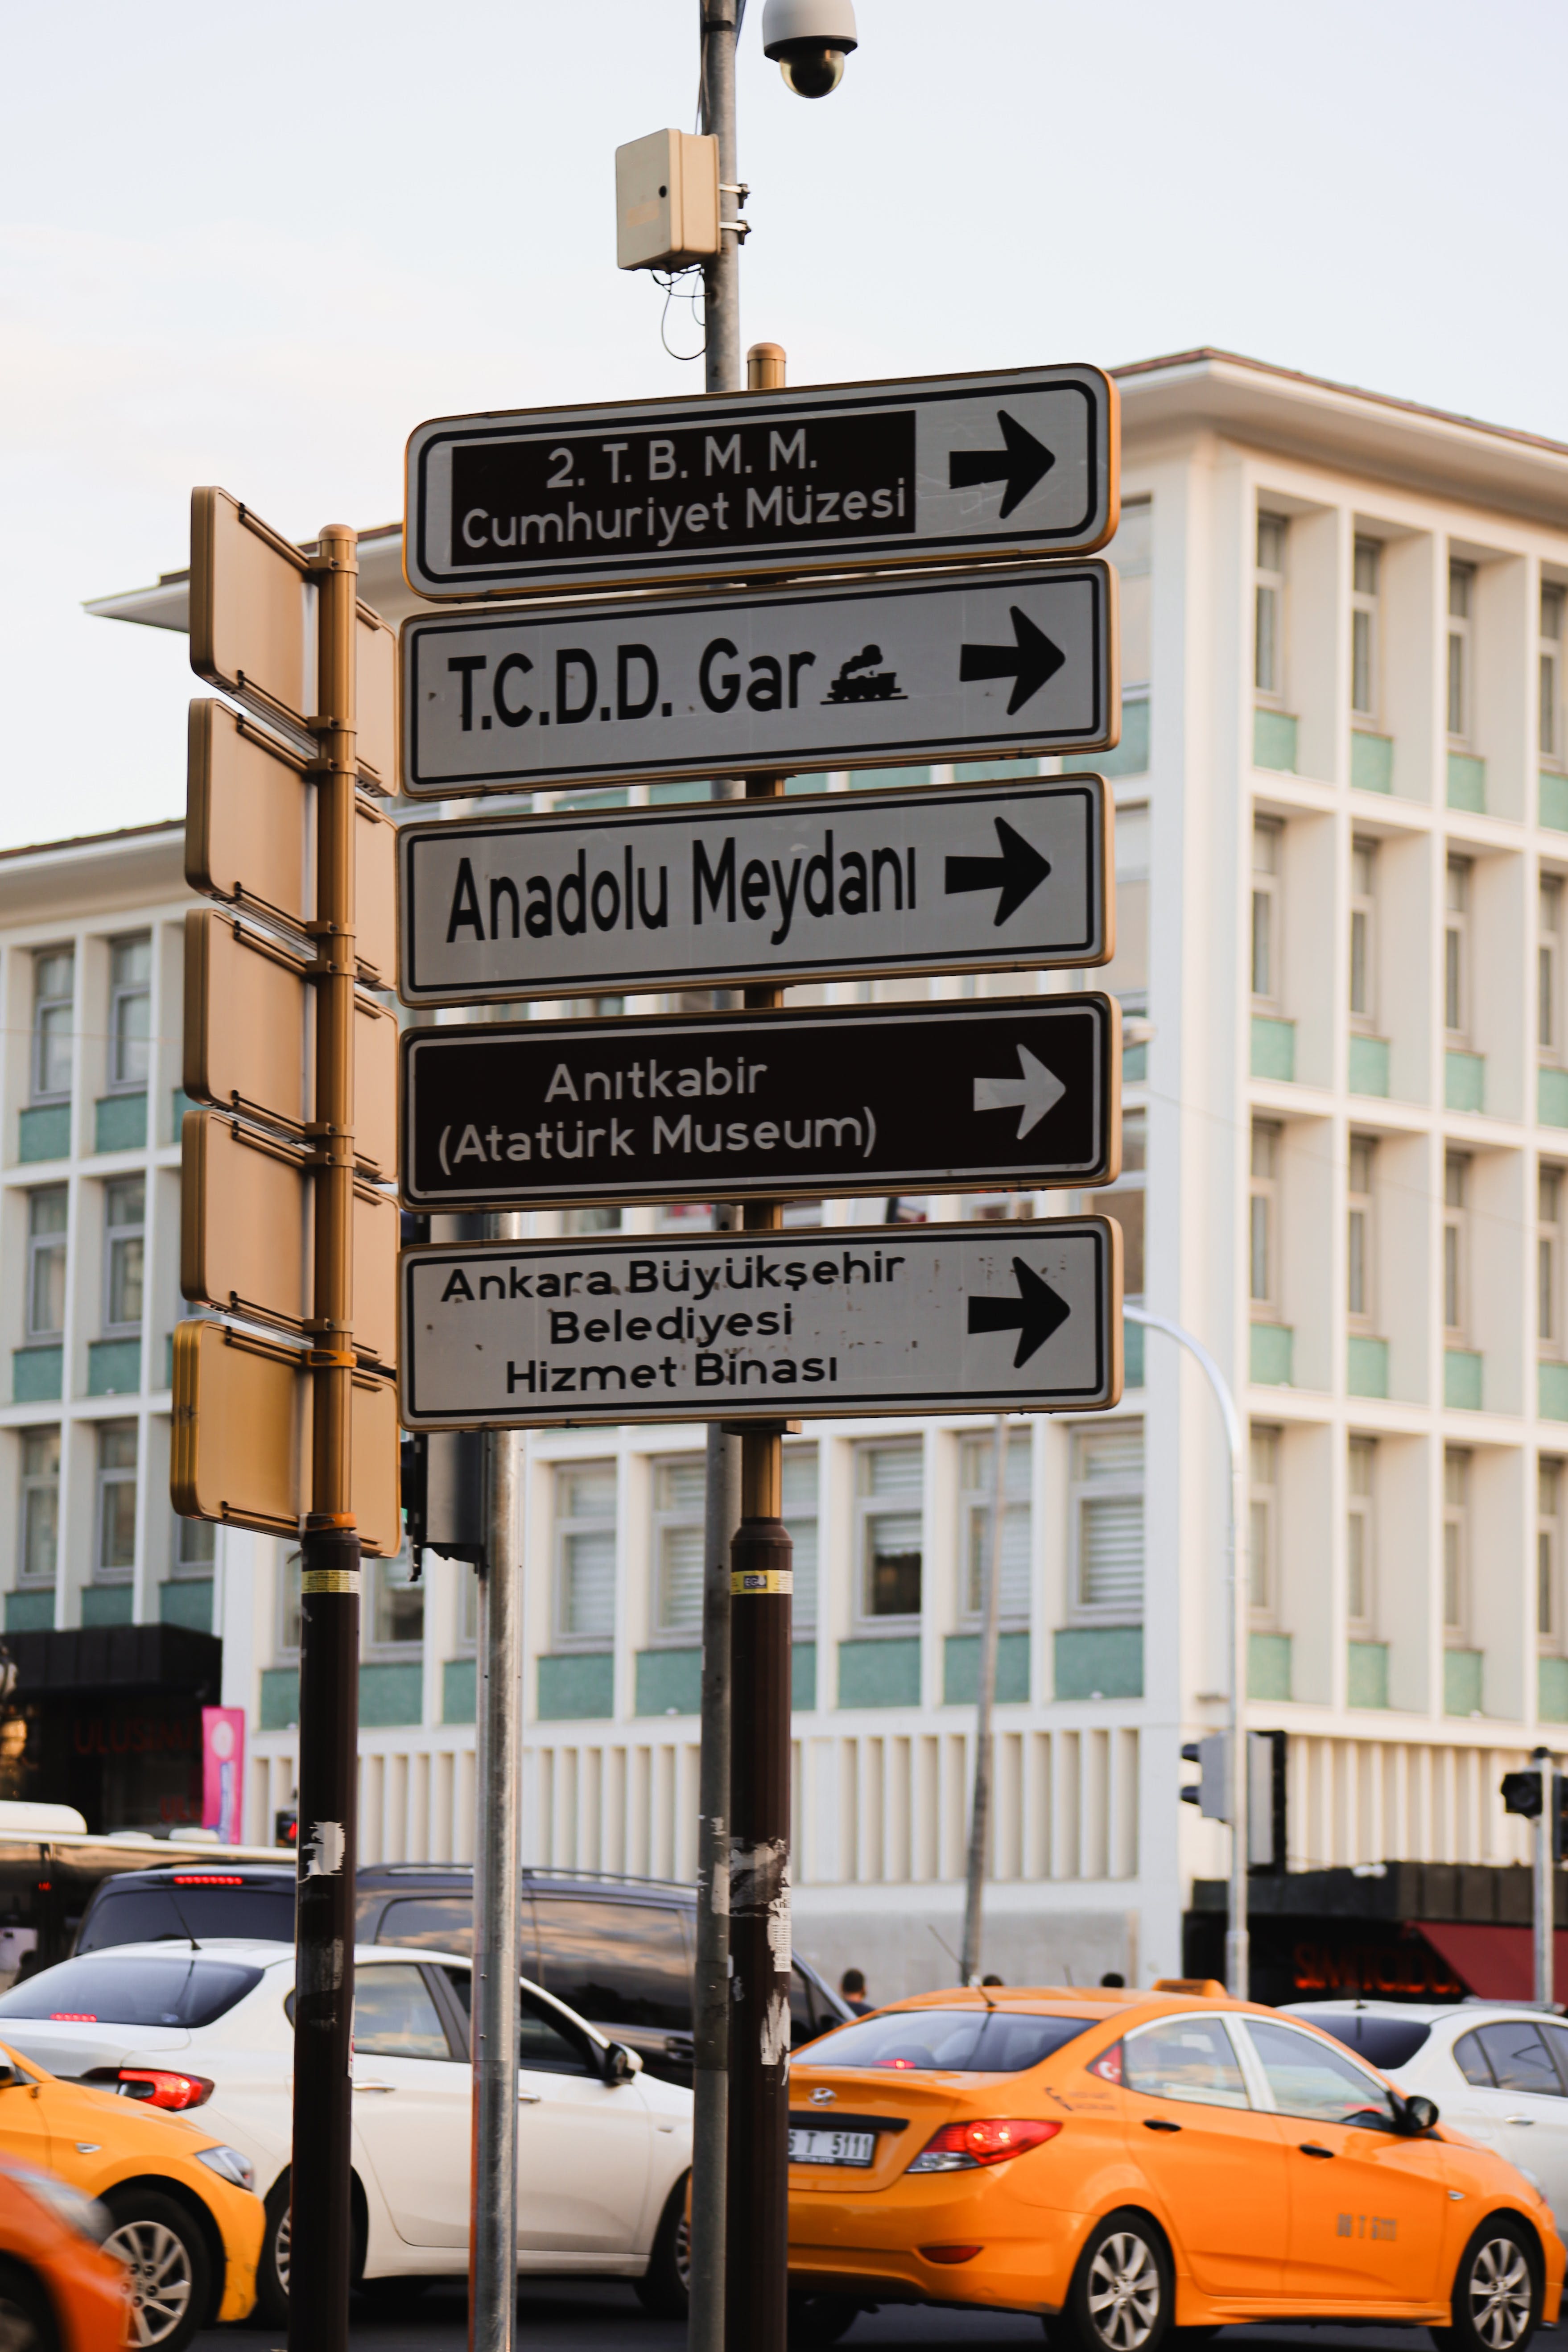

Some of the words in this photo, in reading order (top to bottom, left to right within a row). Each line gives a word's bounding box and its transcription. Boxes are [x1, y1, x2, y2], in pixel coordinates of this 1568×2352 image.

[547, 447, 585, 488] 2.
[602, 442, 631, 483] T.
[649, 439, 688, 481] B.
[705, 433, 752, 476] M.
[770, 428, 817, 471] M.
[462, 492, 729, 548] Cumhuriyet
[747, 478, 904, 528] Müzesi
[447, 644, 672, 732] T.C.D.D.
[699, 638, 816, 713] Gar
[446, 845, 668, 943] Anadolu
[693, 829, 916, 945] Meydanı
[545, 1056, 768, 1102] Anıtkabir
[439, 1118, 635, 1176] (Atatürk
[653, 1106, 876, 1158] Museum)
[441, 1266, 620, 1302] Ankara
[625, 1250, 905, 1300] Büyükşehir
[548, 1303, 792, 1348] Belediyesi
[507, 1356, 677, 1394] Hizmet
[695, 1349, 837, 1386] Binası
[807, 2131, 817, 2154] T
[831, 2133, 870, 2158] 5111
